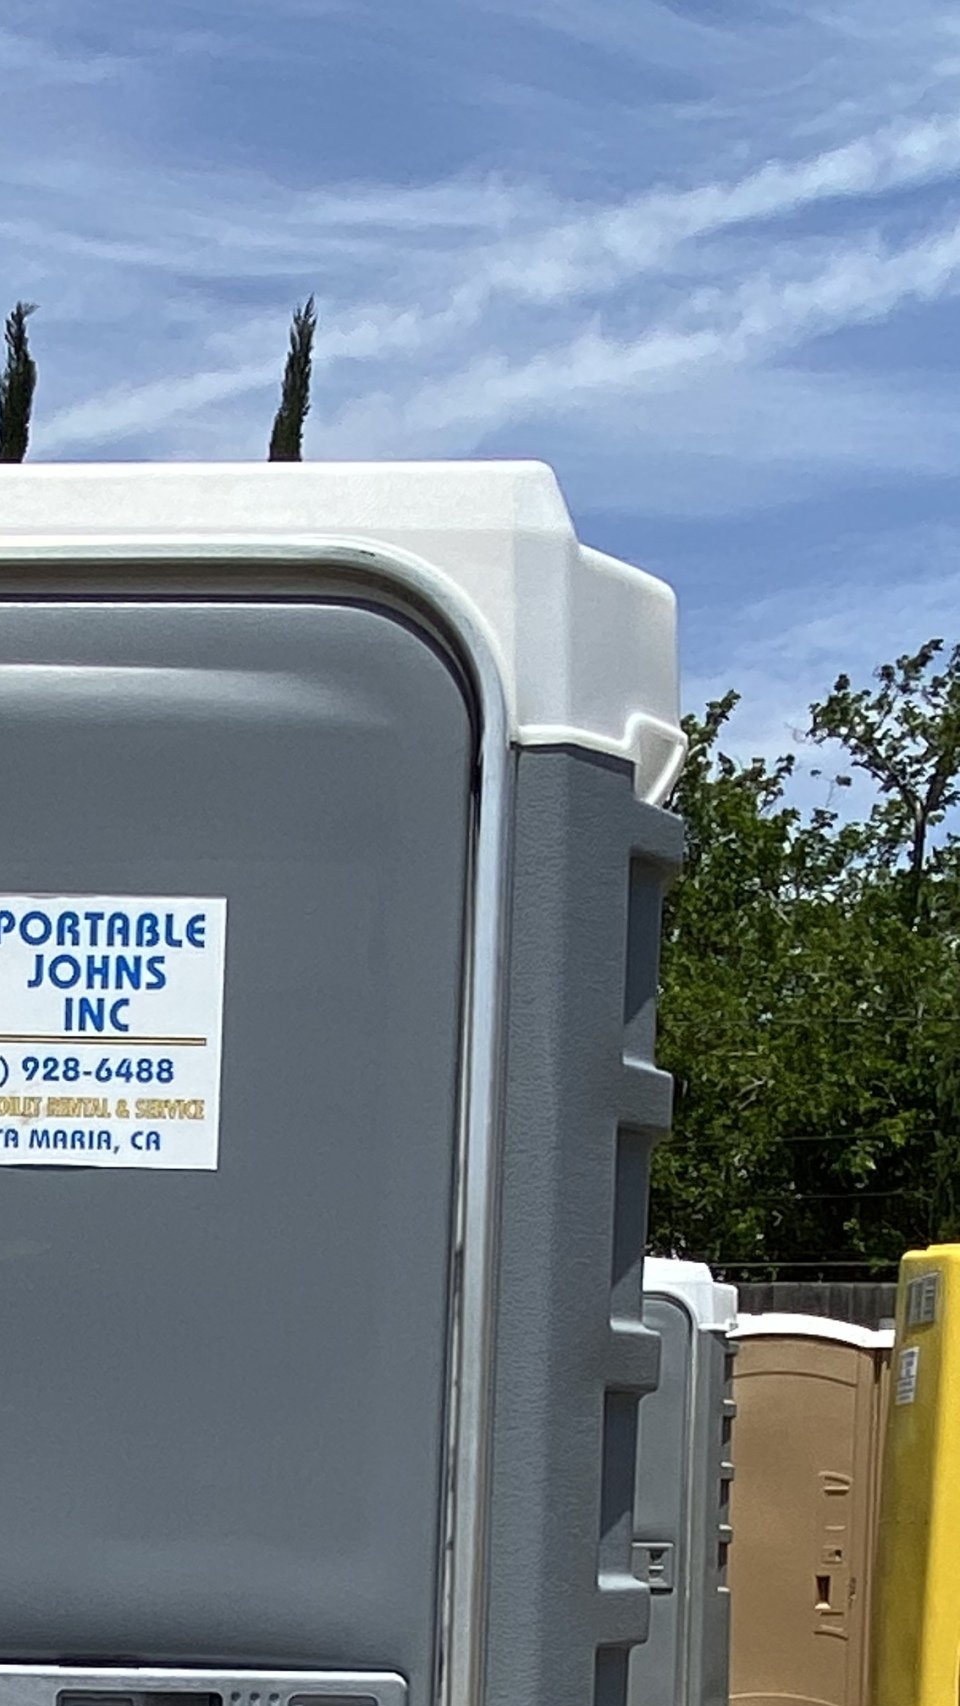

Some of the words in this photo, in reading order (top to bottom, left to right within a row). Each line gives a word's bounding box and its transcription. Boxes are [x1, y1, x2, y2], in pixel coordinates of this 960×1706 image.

[27, 954, 167, 991] JOHNS
[63, 997, 130, 1033] INC
[22, 1056, 174, 1084] 928-6488
[46, 1098, 111, 1119] RENTAL
[115, 1100, 131, 1119] &
[135, 1100, 205, 1120] SERVICE
[28, 1129, 121, 1154] MARIA,
[130, 1131, 161, 1151] CA
